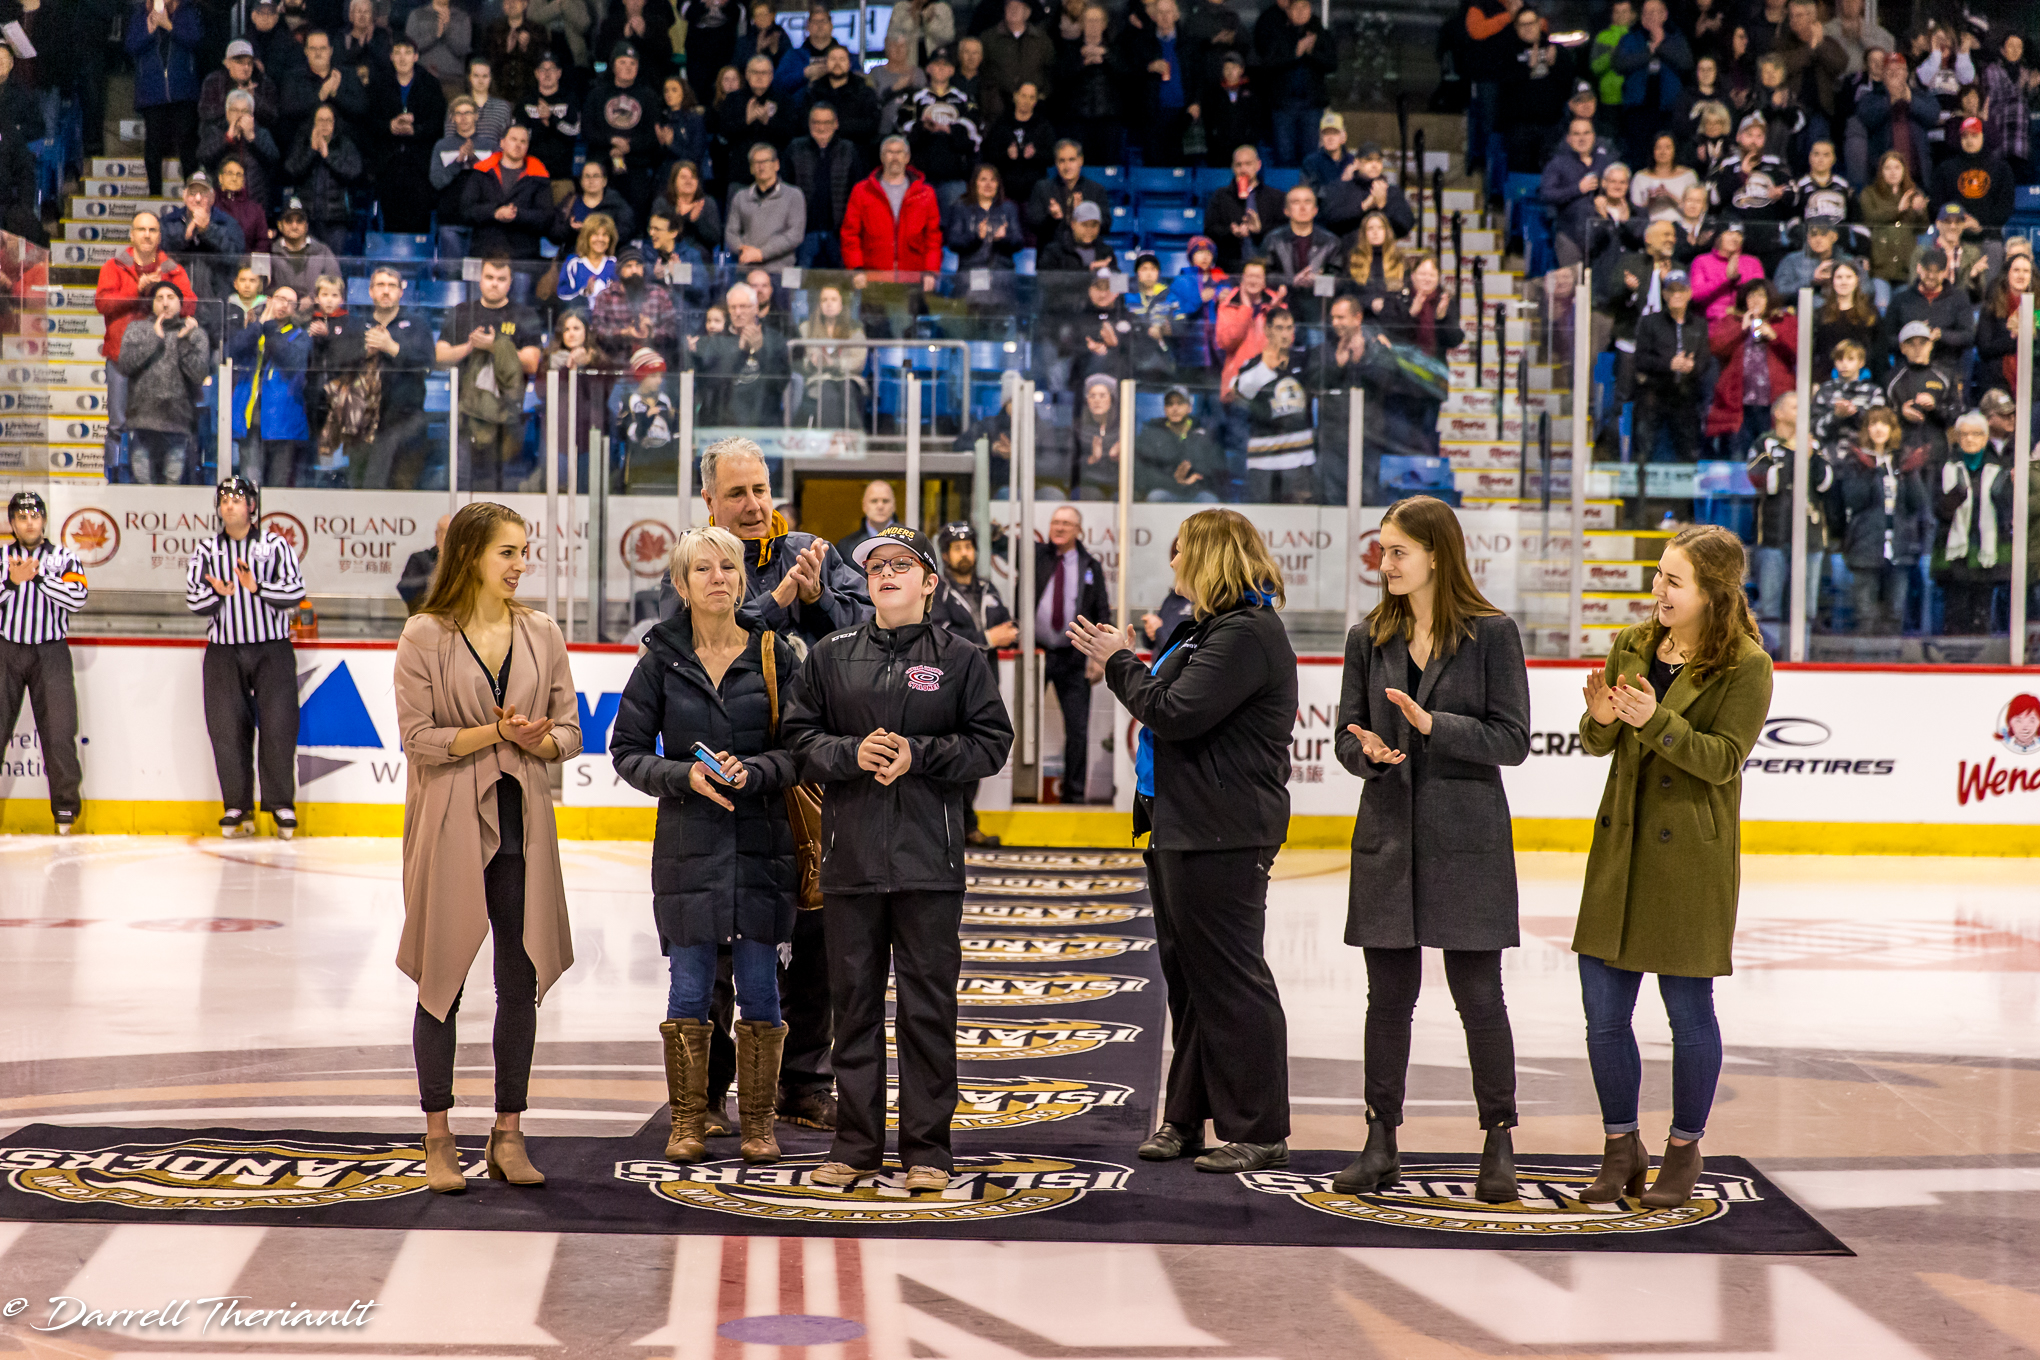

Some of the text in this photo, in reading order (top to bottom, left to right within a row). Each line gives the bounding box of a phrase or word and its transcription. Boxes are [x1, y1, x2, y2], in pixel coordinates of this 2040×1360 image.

[76, 452, 105, 460] Unite
[76, 461, 104, 469] Renta
[314, 515, 417, 537] ROLAND
[146, 532, 202, 555] Tou
[333, 537, 397, 559] Tour
[151, 556, 189, 571] 罗兰商
[1275, 553, 1314, 571] our
[1292, 738, 1330, 762] ur
[1742, 758, 1896, 776] PERTIRES
[958, 1089, 1125, 1106] ISLA
[951, 1109, 1063, 1128] CHARL
[628, 1162, 1122, 1190] ISLANERS
[31, 1175, 404, 1208] CHARLOTTETOWN
[676, 1188, 1053, 1222] CHARLOTTETOWN
[1322, 1199, 1701, 1232] CHARLOTTETOWN
